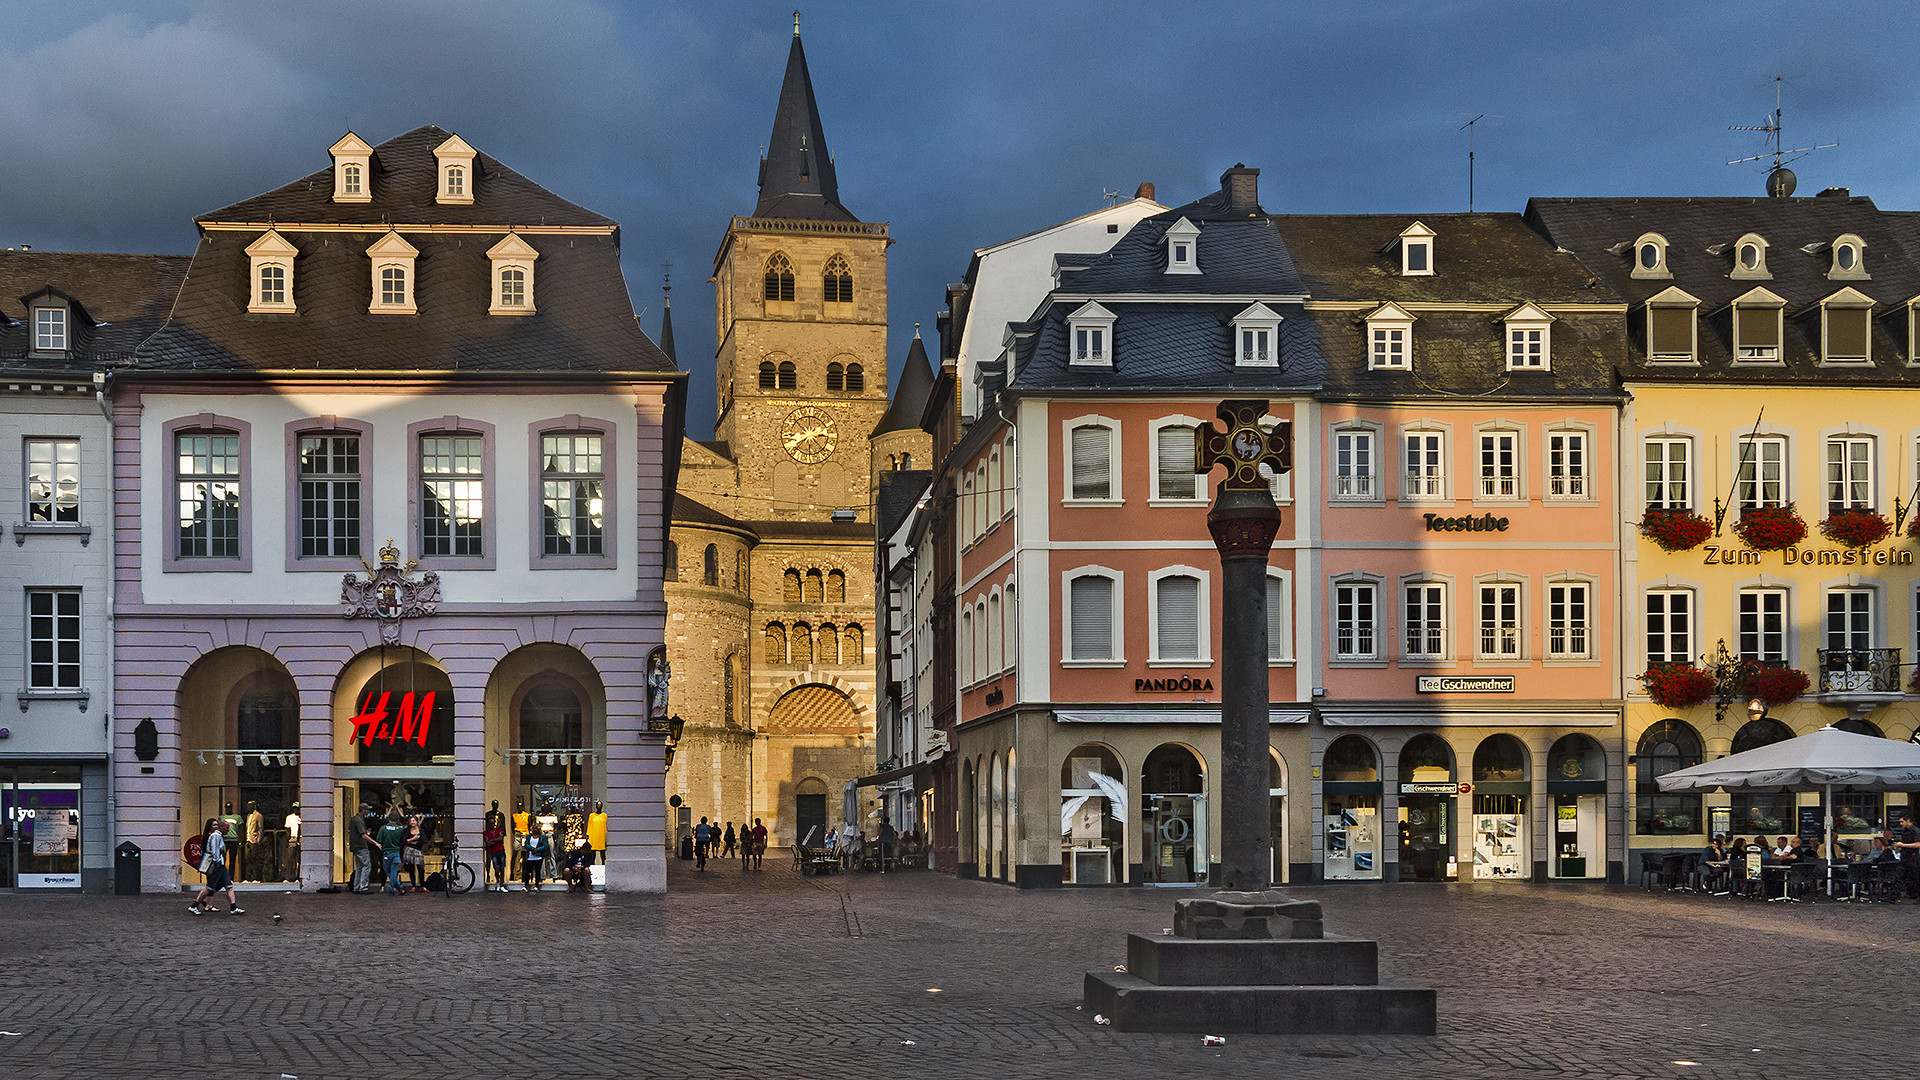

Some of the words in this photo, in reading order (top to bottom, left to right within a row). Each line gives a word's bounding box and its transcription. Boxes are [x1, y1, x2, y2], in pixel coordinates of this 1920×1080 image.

[1423, 512, 1510, 532] Teestube
[1703, 545, 1762, 565] Zum
[1782, 545, 1914, 566] Domstein
[1421, 679, 1440, 690] Tee
[1441, 678, 1512, 691] Gschwendner
[348, 690, 436, 748] H&M
